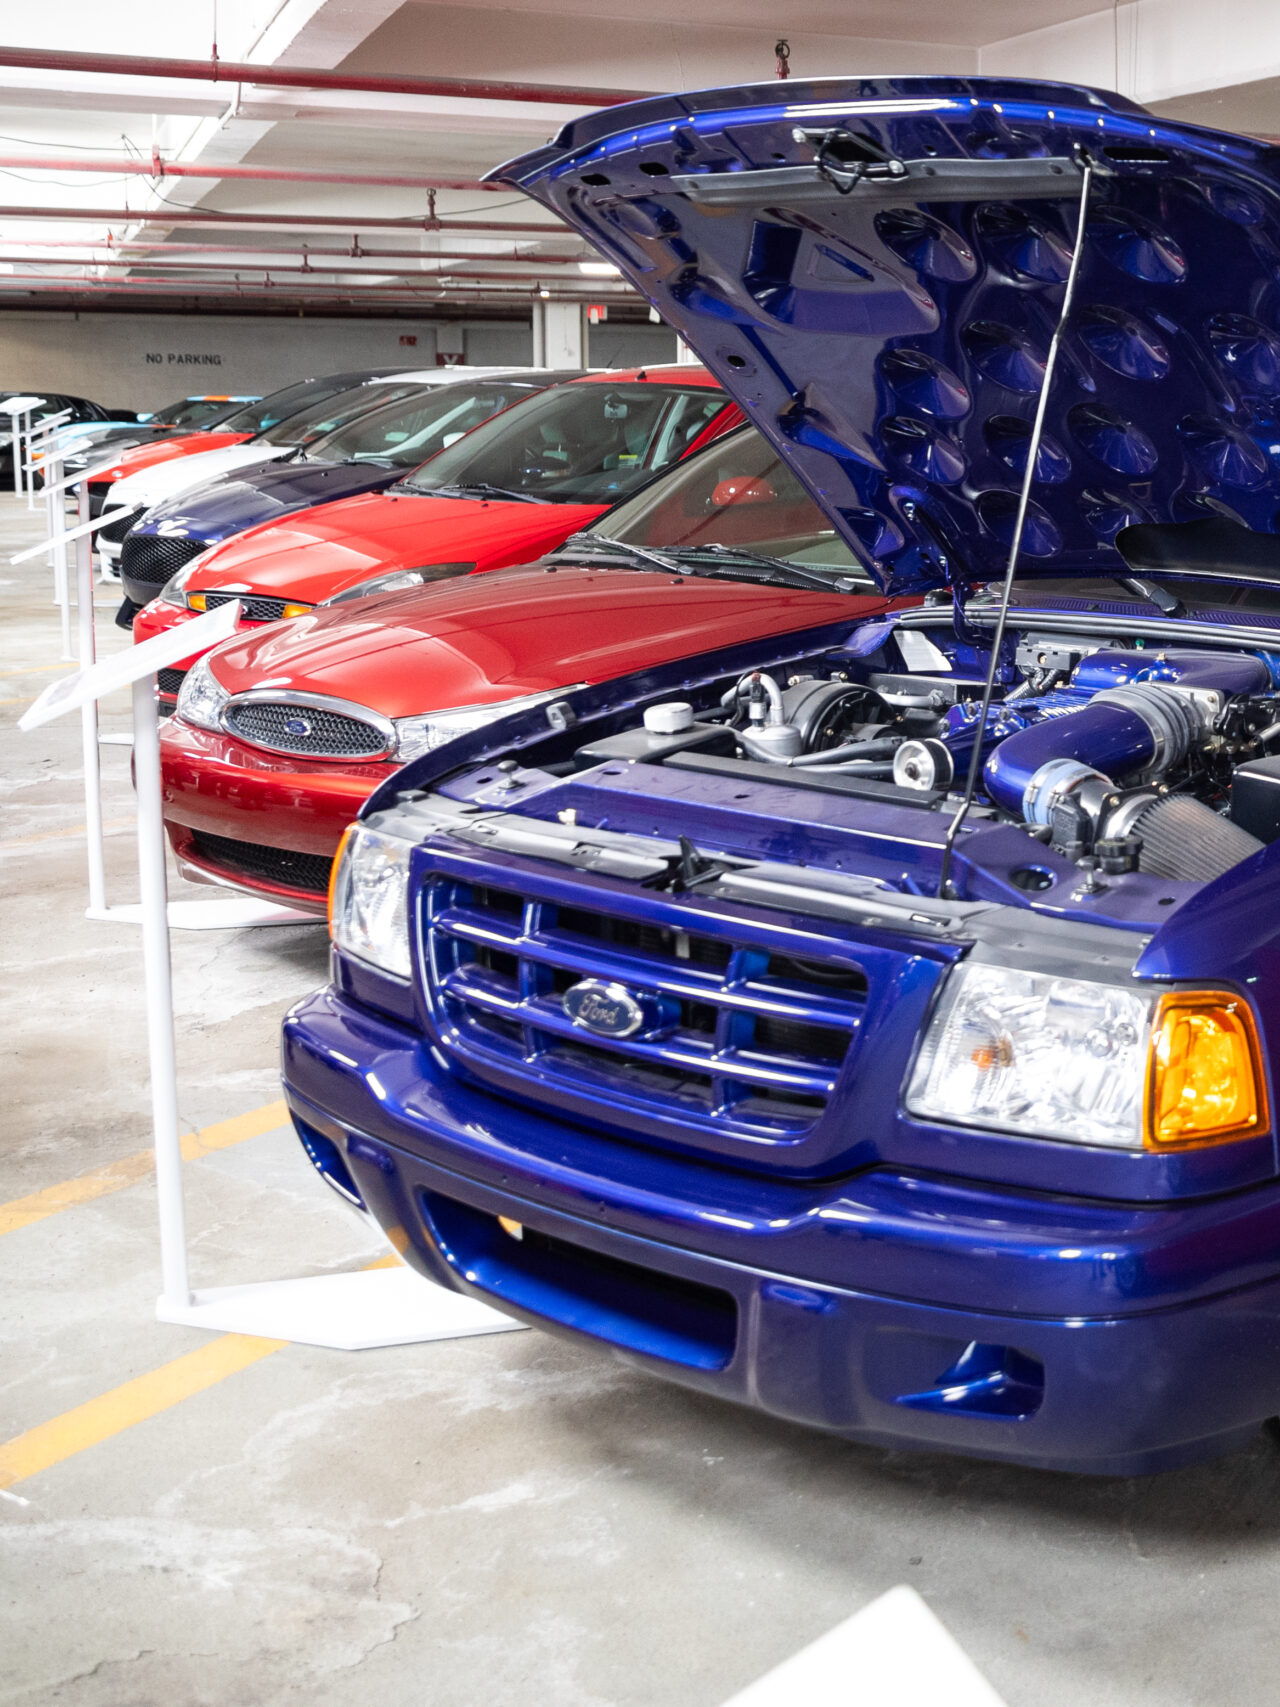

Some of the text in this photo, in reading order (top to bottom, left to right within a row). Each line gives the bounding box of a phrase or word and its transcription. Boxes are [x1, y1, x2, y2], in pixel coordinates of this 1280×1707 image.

[146, 353, 222, 366] NO PARKING
[578, 993, 620, 1025] Ford
